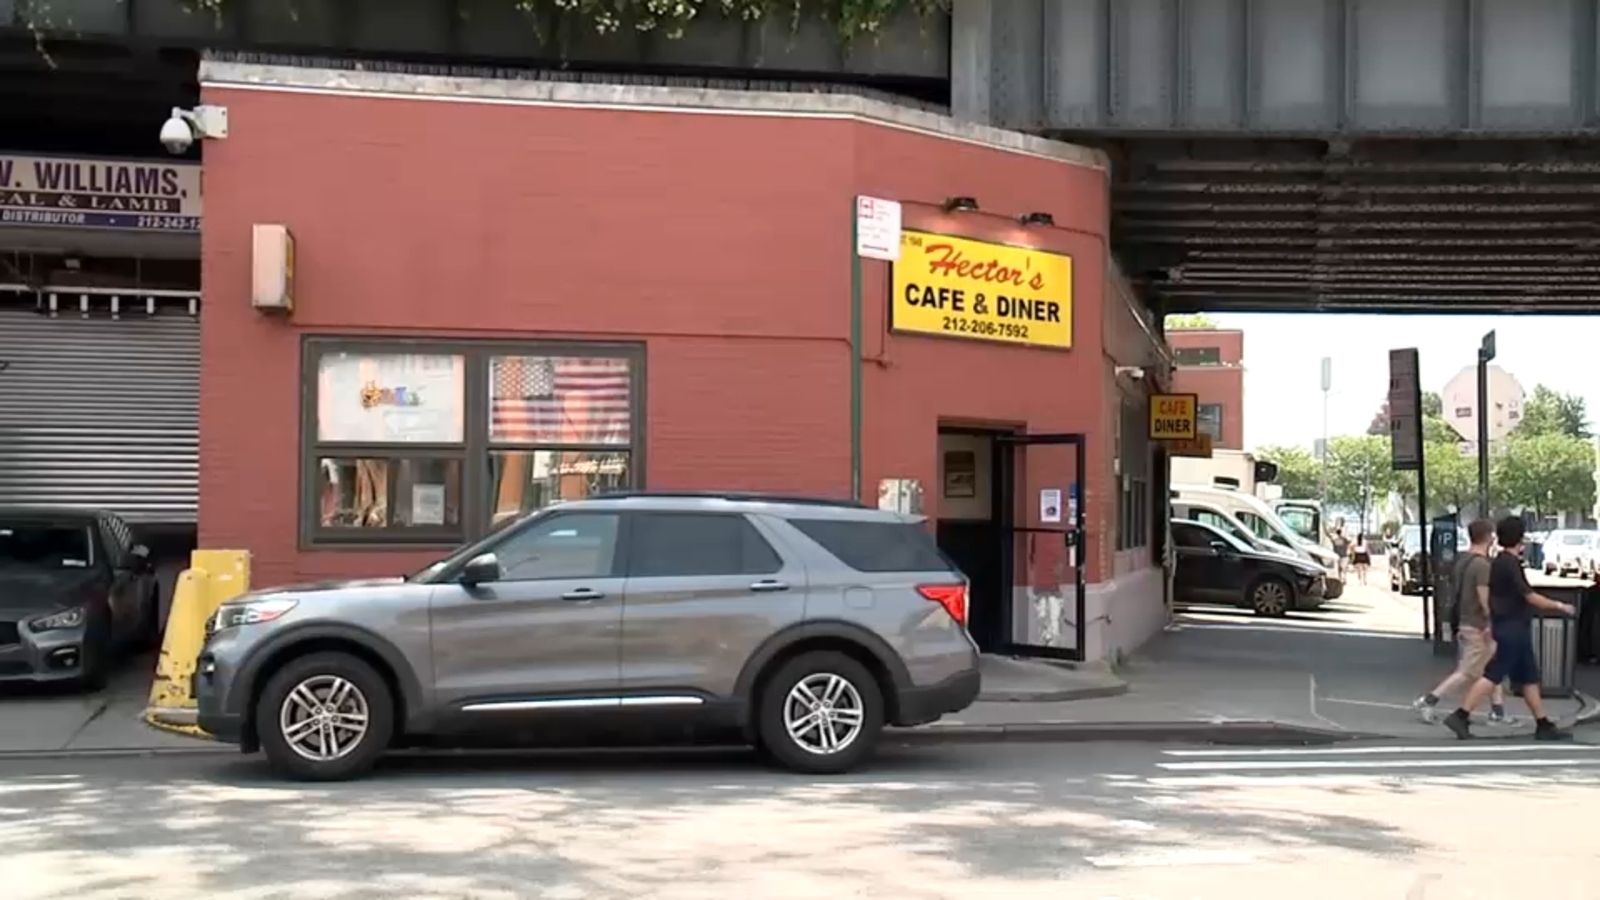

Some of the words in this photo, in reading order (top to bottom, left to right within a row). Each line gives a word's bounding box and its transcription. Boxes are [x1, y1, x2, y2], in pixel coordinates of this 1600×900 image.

[33, 161, 187, 198] WILLIAMS,
[58, 194, 77, 207] &
[91, 195, 169, 211] LAMB
[2, 209, 85, 224] DISTRIBUTOR
[925, 244, 1044, 291] Hector's
[905, 283, 965, 312] CAFE
[973, 293, 989, 314] &
[997, 296, 1060, 322] DINER
[943, 316, 1029, 338] 212-206-7592
[1160, 401, 1187, 416] CAFE
[1155, 419, 1191, 433] DINER
